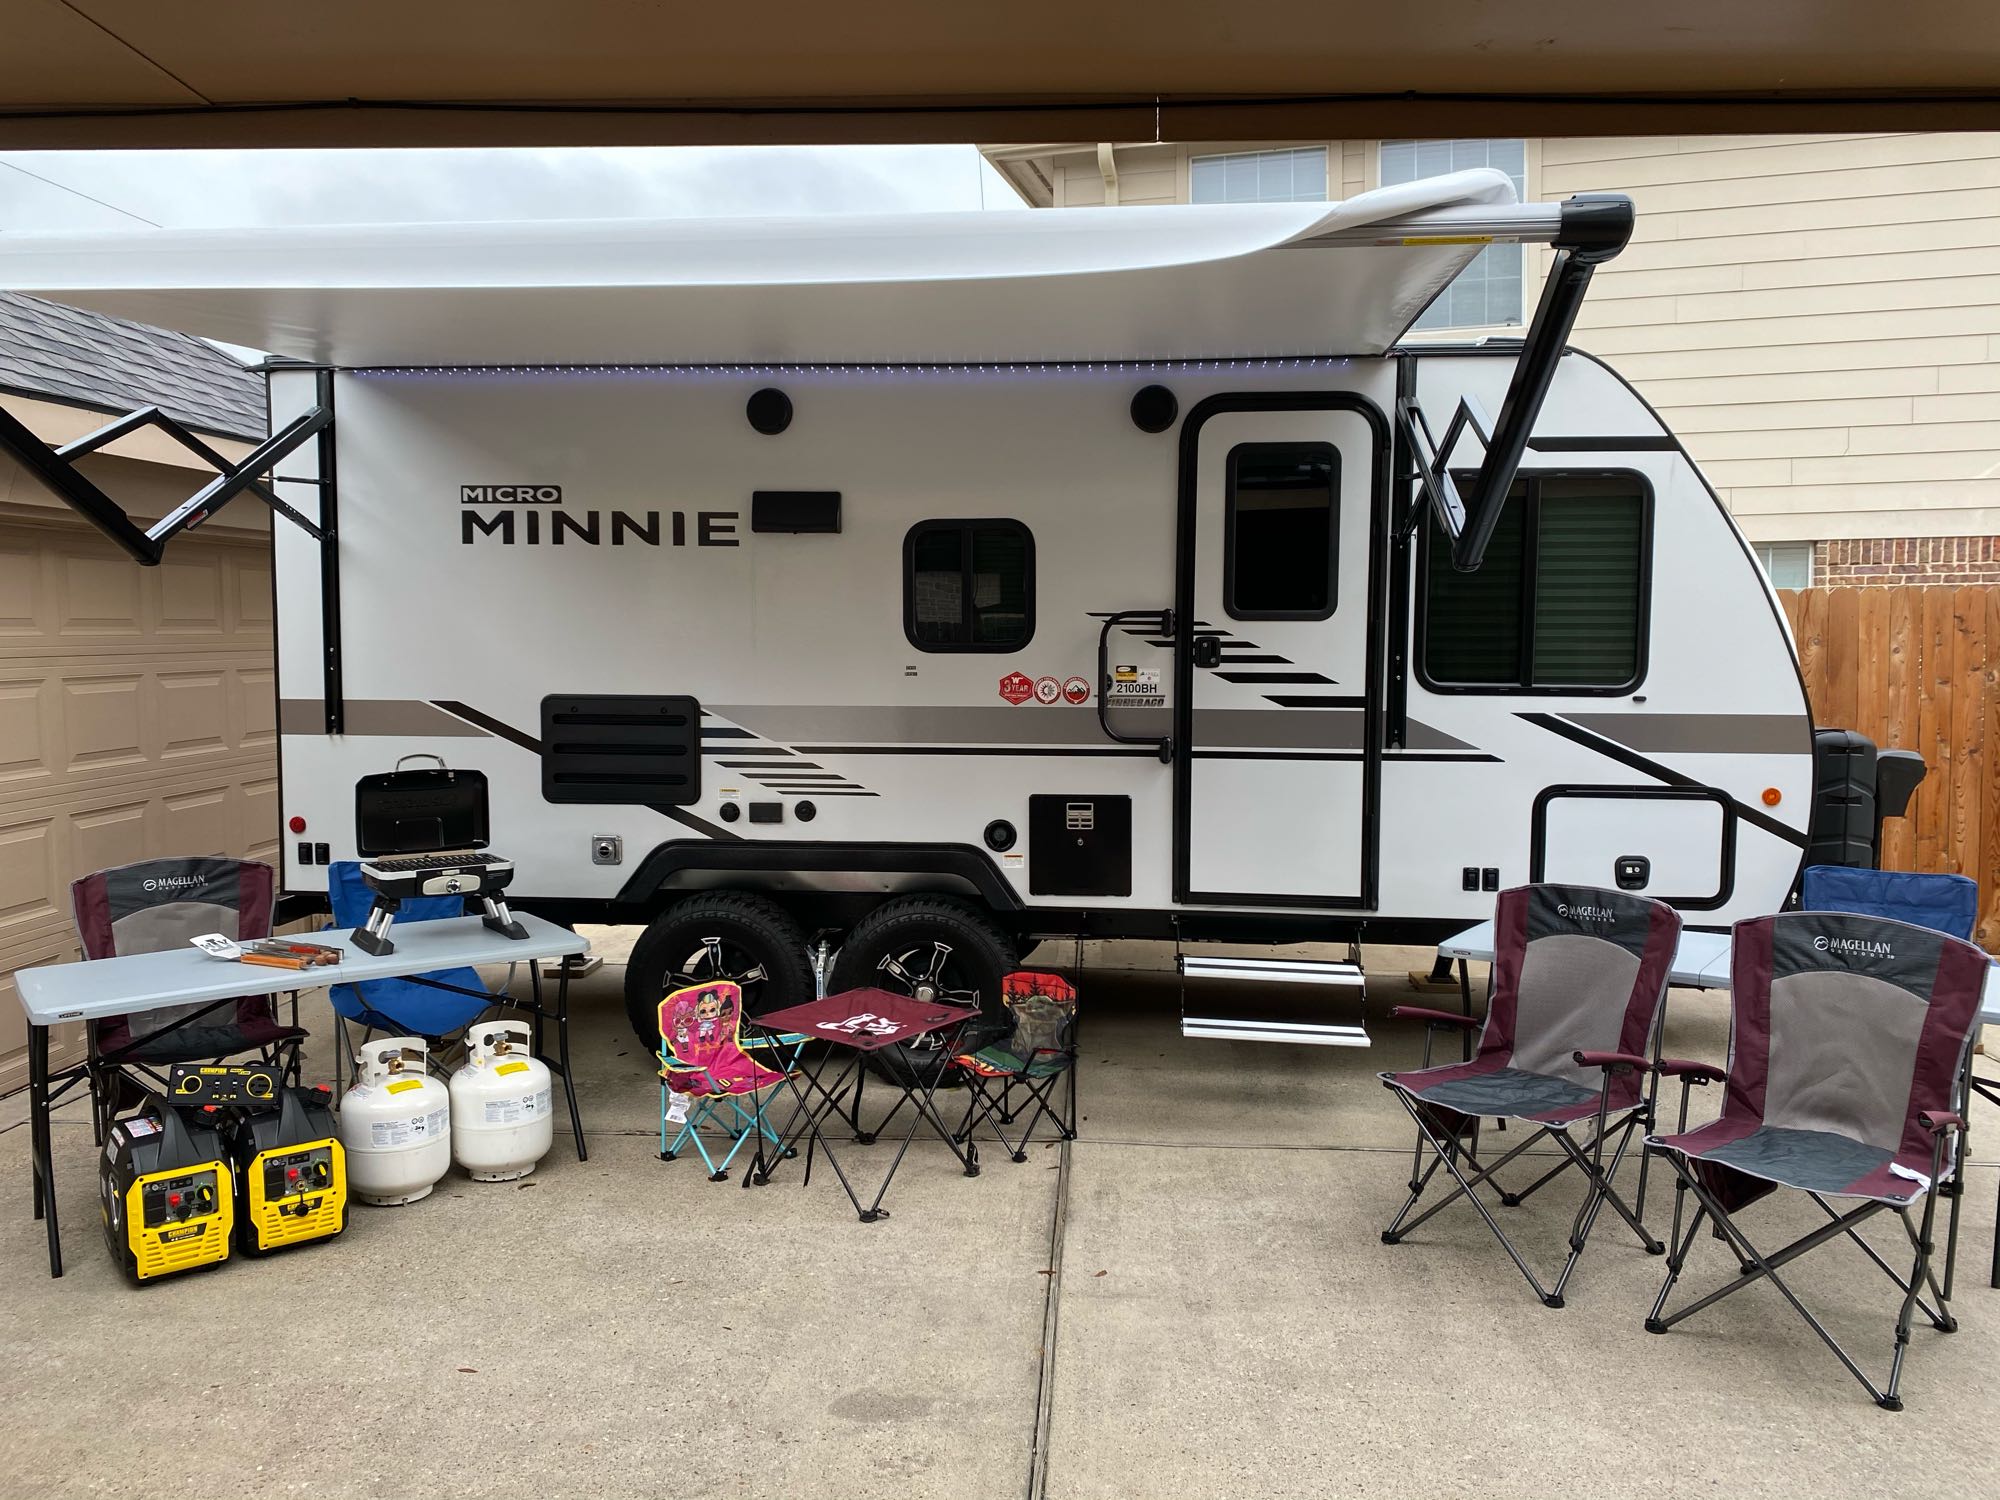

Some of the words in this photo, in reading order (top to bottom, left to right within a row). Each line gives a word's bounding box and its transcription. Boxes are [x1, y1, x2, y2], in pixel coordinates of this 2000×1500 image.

[462, 487, 559, 502] MICRO
[461, 510, 739, 546] MINNIE
[1011, 684, 1029, 692] YEAR
[1116, 683, 1157, 693] 2100BH
[158, 874, 205, 887] MAGELLAN
[1569, 904, 1613, 918] MAGELLAN
[1830, 937, 1891, 954] MAGELLAN
